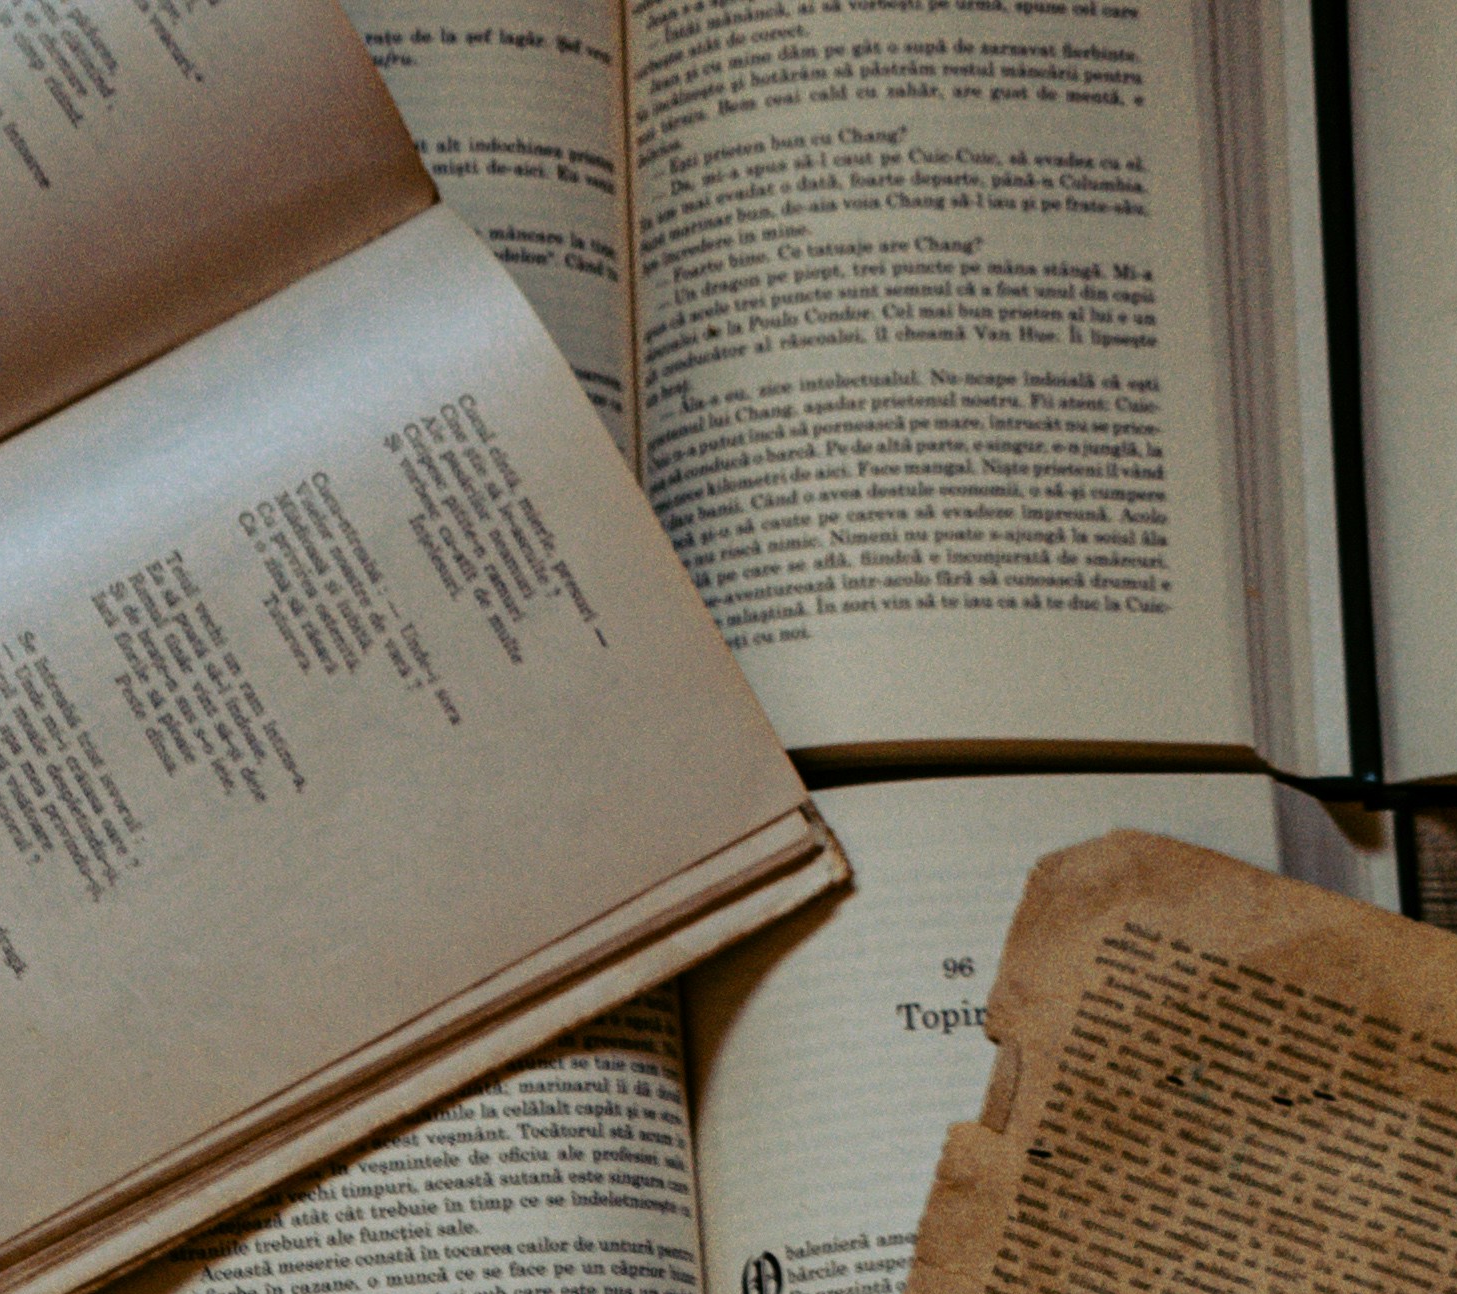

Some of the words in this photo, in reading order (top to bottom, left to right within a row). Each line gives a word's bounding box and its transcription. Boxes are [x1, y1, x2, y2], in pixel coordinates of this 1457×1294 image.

[941, 956, 976, 980] 96
[896, 1000, 988, 1035] Topir
[200, 1259, 276, 1283] Această
[277, 1255, 352, 1276] meserie
[353, 1245, 417, 1268] constă
[419, 1244, 441, 1263] în
[442, 1242, 514, 1261] tocarea
[515, 1235, 570, 1255] cailor
[572, 1234, 596, 1254] de
[597, 1238, 656, 1257] untură
[786, 1260, 849, 1285] bărcile
